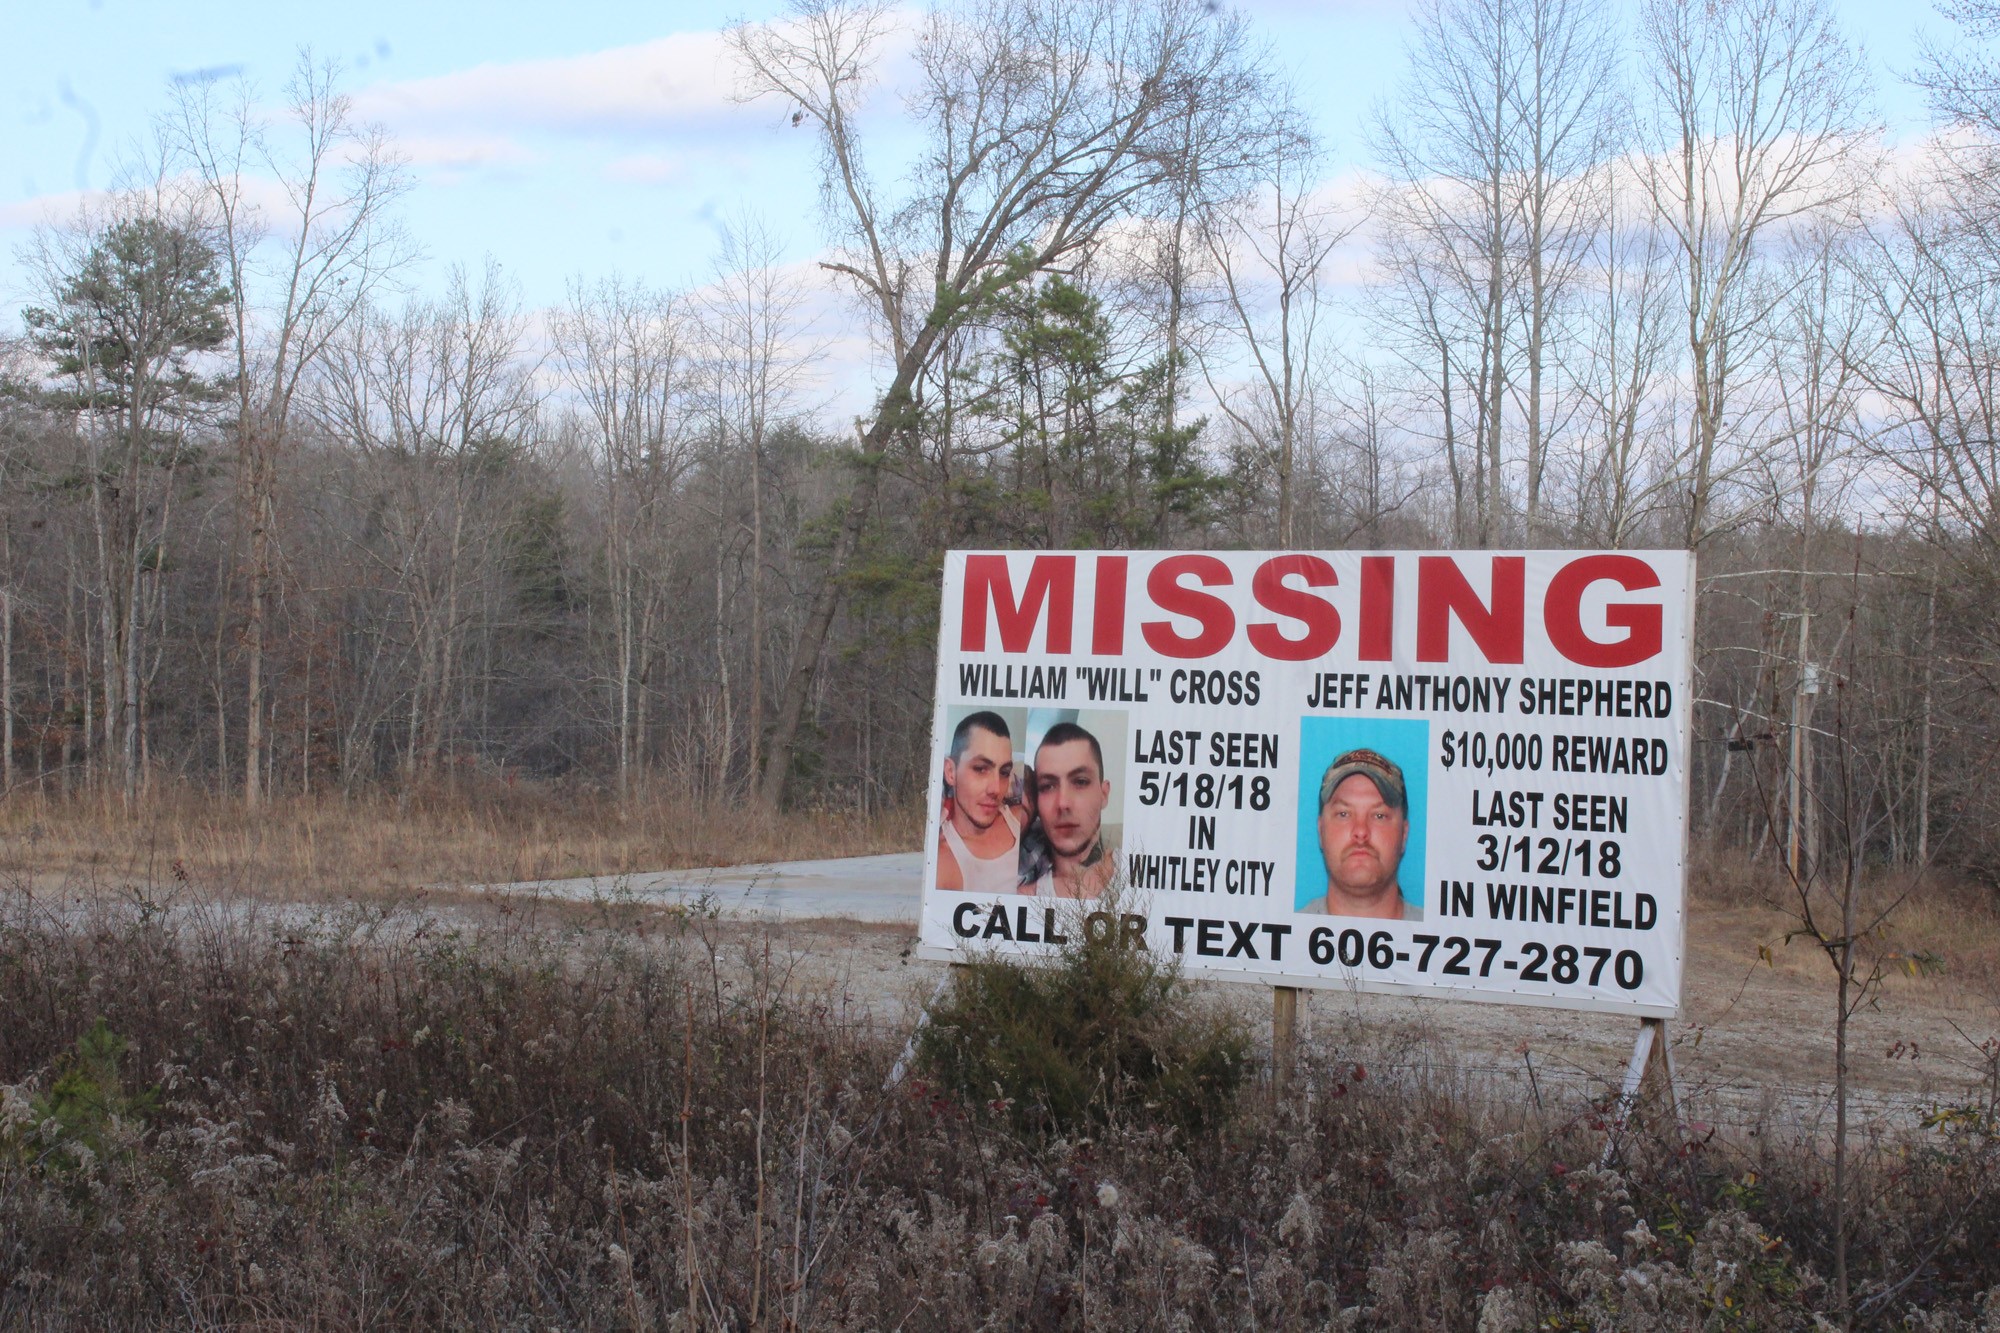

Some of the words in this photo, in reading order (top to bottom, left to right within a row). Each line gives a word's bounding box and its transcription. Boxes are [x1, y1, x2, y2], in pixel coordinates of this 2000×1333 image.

[960, 554, 1664, 668] MISSING
[959, 663, 1067, 700] WILLIAM
[1076, 667, 1162, 702] "WILL"
[1170, 669, 1261, 706] CROSS
[1307, 673, 1370, 710] JEFF
[1375, 675, 1511, 713] ANTHONY
[1519, 679, 1672, 718] SHEPHERD
[1134, 729, 1201, 766] LAST
[1209, 732, 1279, 769] SEEN
[1441, 729, 1543, 777] $10,000
[1552, 735, 1668, 776] REWARD
[1138, 771, 1271, 811] 5/18/18
[1472, 789, 1544, 829] LAST
[1553, 793, 1628, 833] SEEN
[1189, 816, 1216, 850] IN
[1129, 854, 1221, 893] WHITLEY
[1225, 860, 1275, 896] CITY
[1476, 834, 1621, 878] 3/12/18
[1440, 880, 1474, 917] IN
[1487, 884, 1658, 931] WINFIELD
[952, 902, 1067, 944] CALL
[1165, 917, 1292, 961] TEXT
[1308, 927, 1644, 989] 606-727-2870
